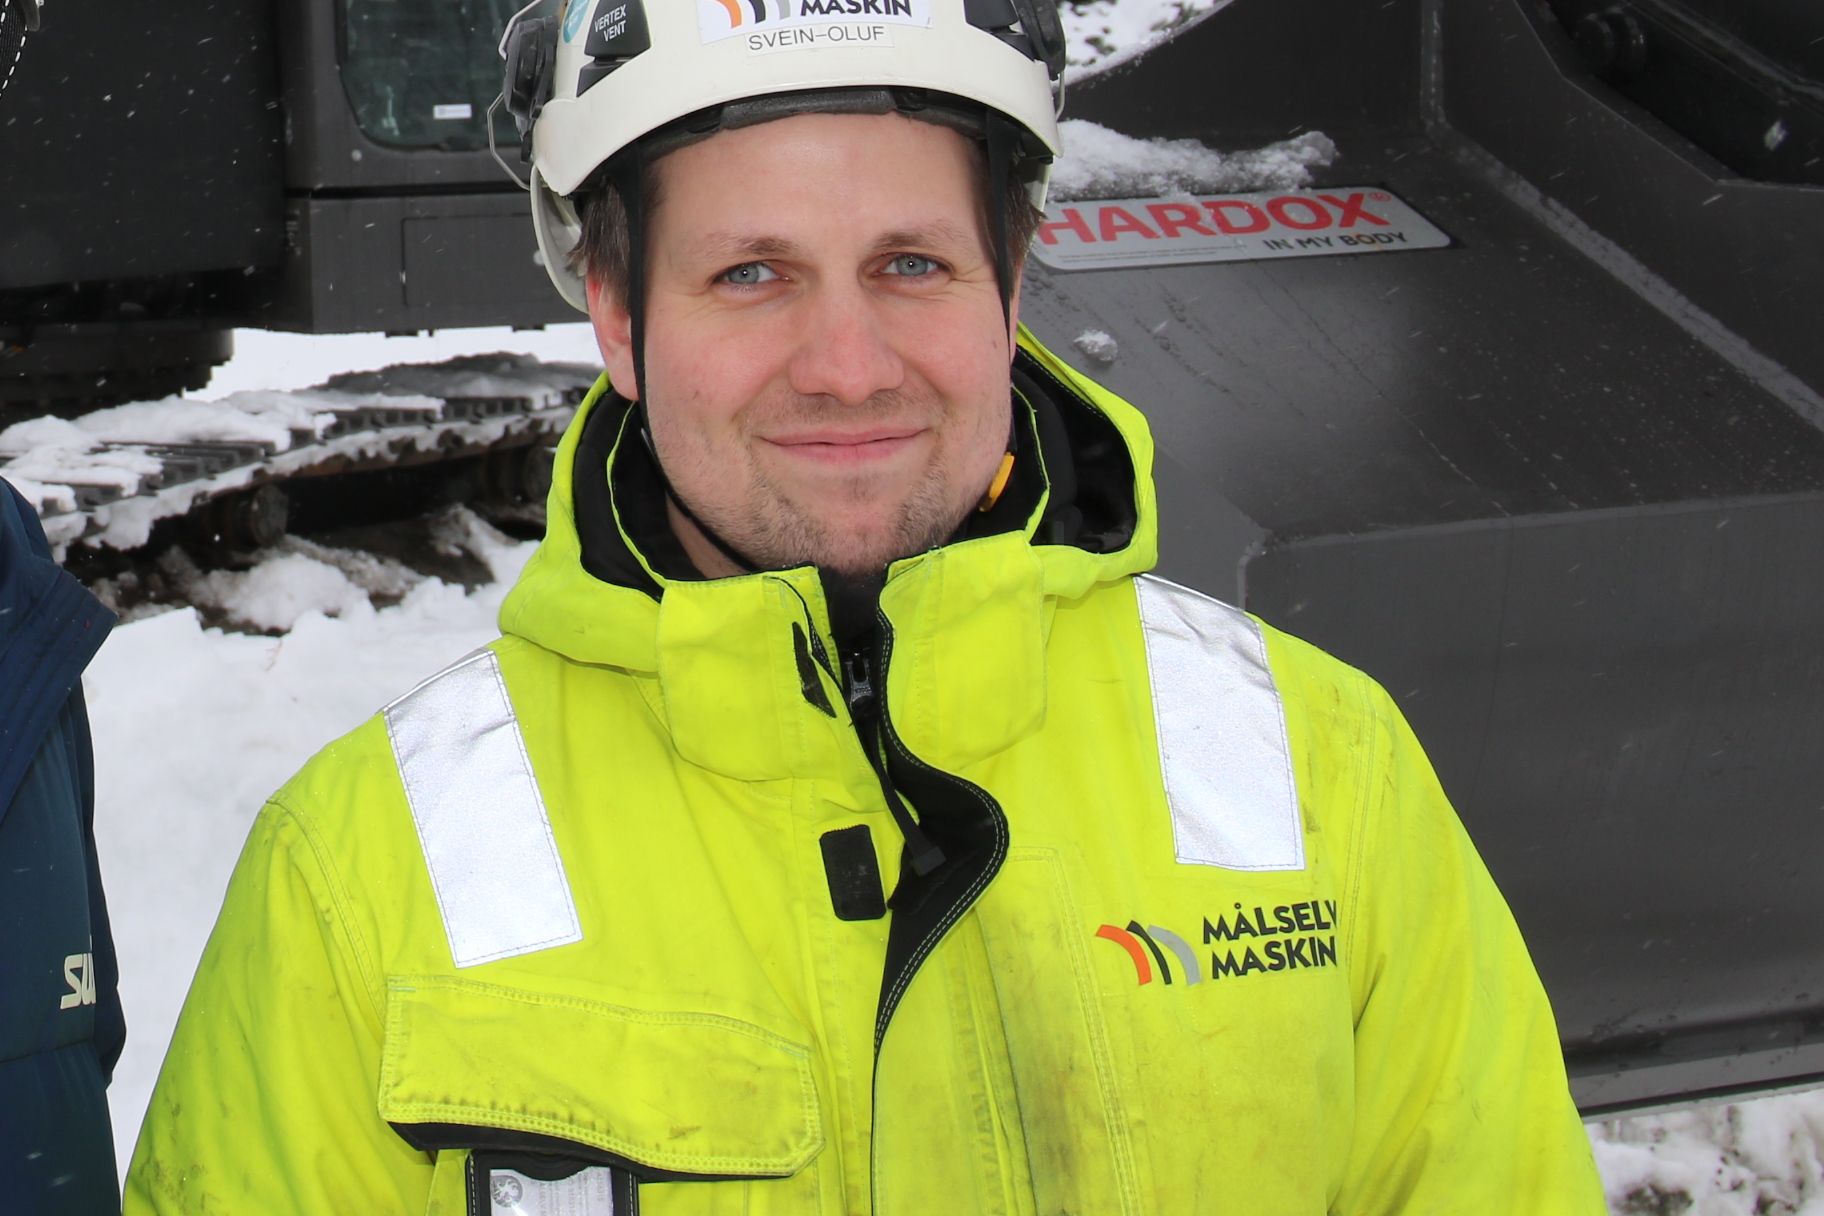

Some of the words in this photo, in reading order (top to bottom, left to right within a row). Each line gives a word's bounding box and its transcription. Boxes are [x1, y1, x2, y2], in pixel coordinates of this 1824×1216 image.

[594, 4, 627, 32] VERTEX
[603, 20, 627, 42] VENT
[748, 25, 885, 51] SVEIN-OLUF
[1039, 192, 1391, 246] HARDOX
[1263, 238, 1293, 252] IN
[1297, 234, 1333, 250] MY
[1340, 230, 1408, 248] BODY
[1212, 935, 1338, 980] MASKIN
